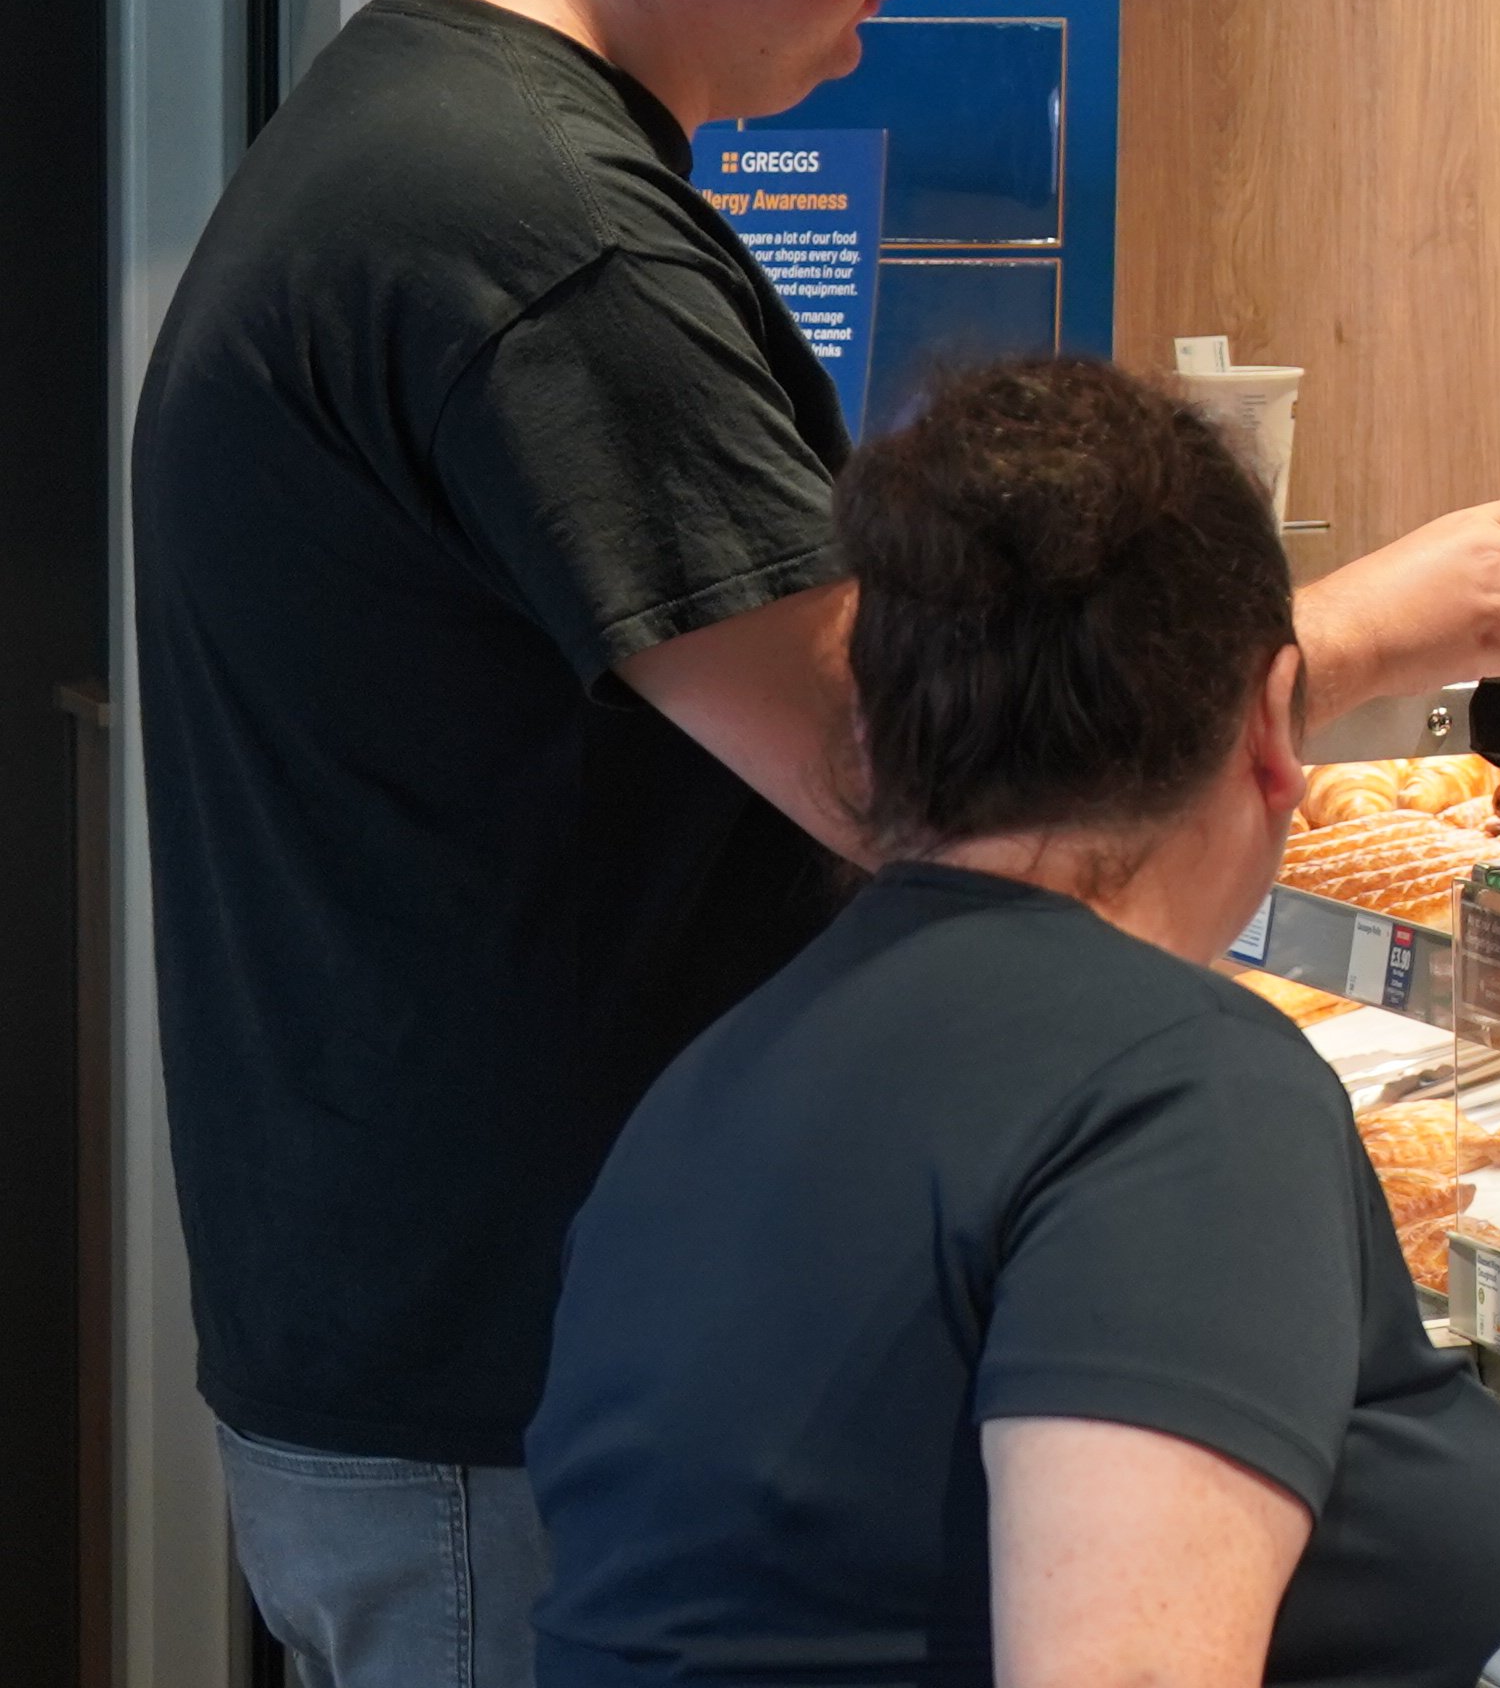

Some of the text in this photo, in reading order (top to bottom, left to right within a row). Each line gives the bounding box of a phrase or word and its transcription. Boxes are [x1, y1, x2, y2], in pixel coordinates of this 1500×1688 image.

[742, 151, 820, 172] GREGGS
[752, 189, 848, 210] Awareness
[775, 234, 782, 244] a
[783, 231, 798, 244] lot
[799, 231, 812, 244] of
[812, 234, 831, 244] our
[832, 231, 857, 244] food
[755, 248, 861, 265] our shops every day.
[822, 264, 833, 278] in
[834, 267, 854, 278] our
[798, 282, 858, 299] equipment.
[801, 311, 844, 327] manage
[814, 327, 853, 341] cannot
